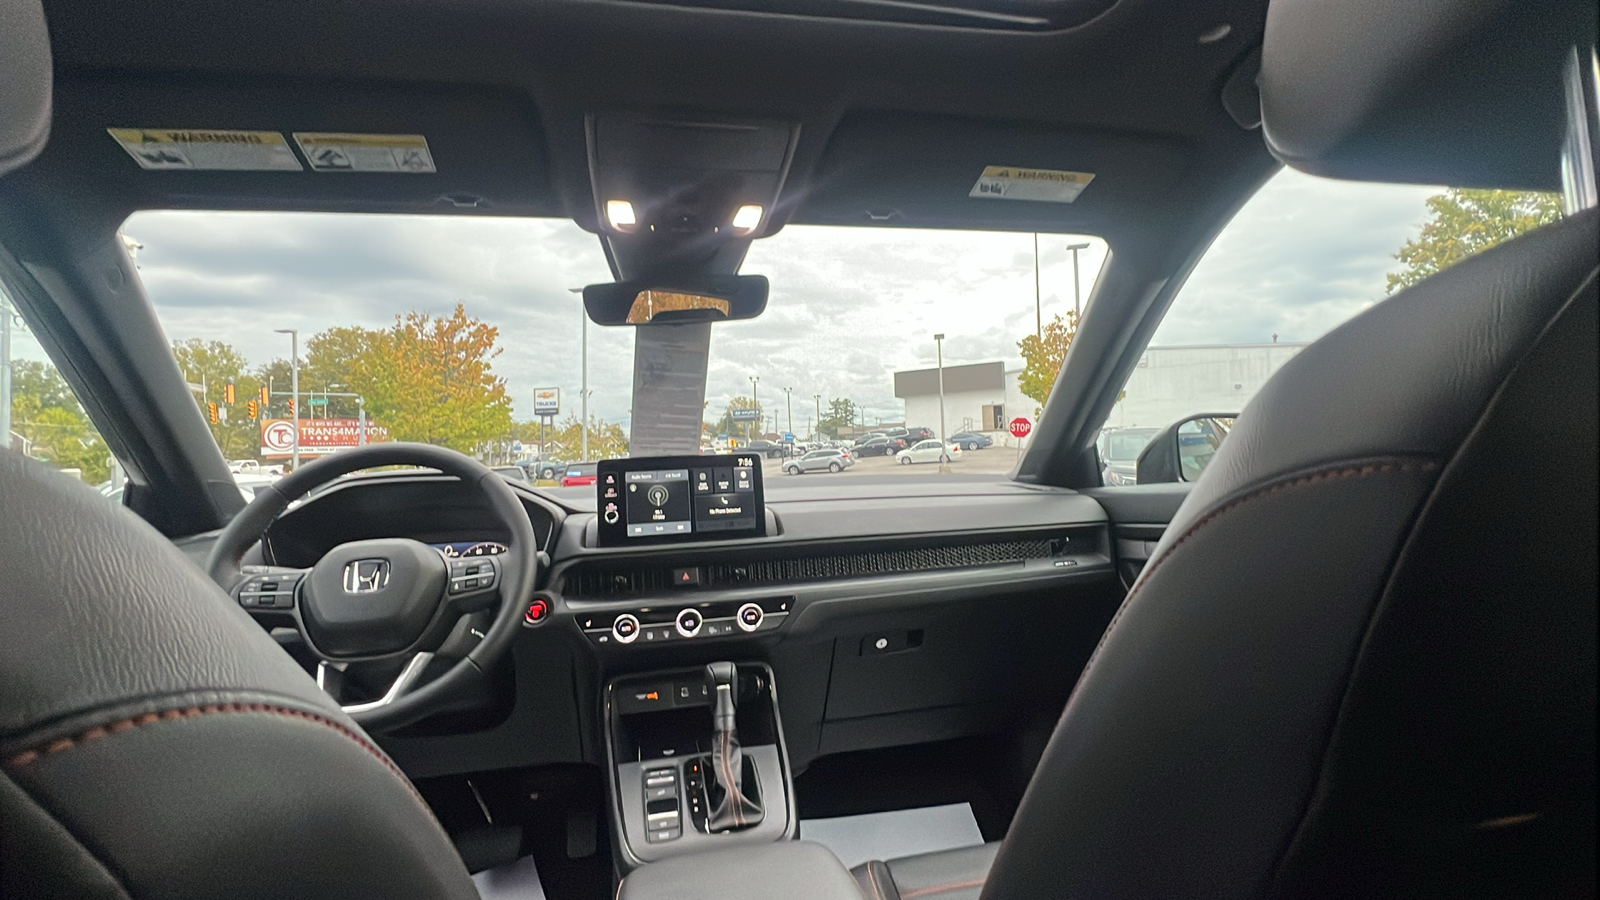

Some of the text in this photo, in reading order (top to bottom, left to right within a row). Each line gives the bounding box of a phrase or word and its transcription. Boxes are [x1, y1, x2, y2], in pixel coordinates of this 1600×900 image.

[301, 427, 388, 436] TRANS4MAION
[1011, 423, 1030, 432] STOP
[738, 458, 753, 467] 7:56
